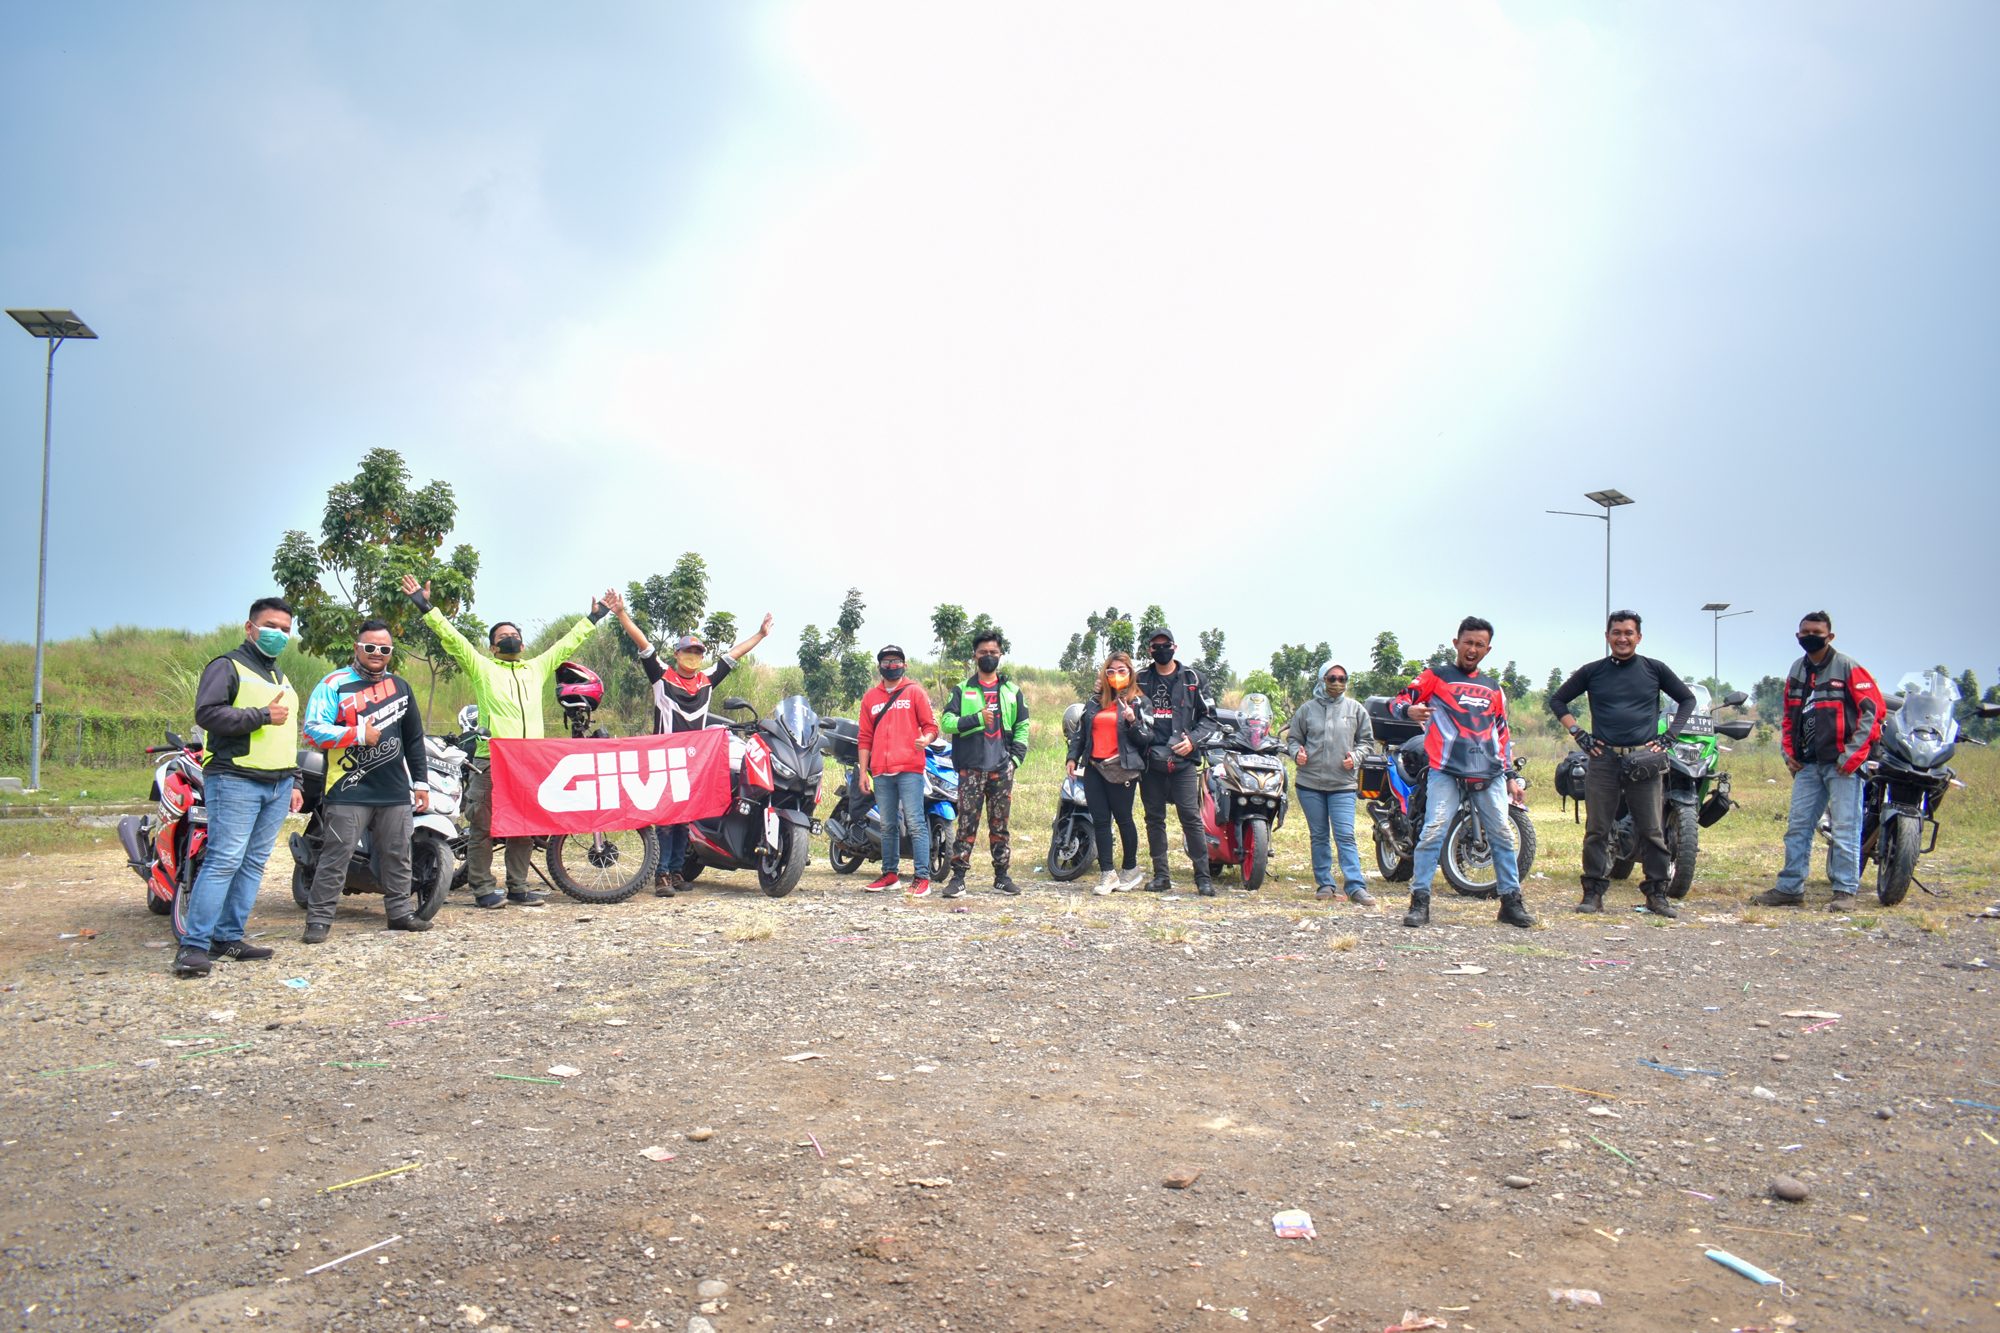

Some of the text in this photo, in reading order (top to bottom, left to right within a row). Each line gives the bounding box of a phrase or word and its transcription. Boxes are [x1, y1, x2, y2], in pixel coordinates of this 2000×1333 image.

[1855, 682, 1872, 690] GIVI
[337, 737, 400, 773] Since
[348, 769, 367, 784] 2014
